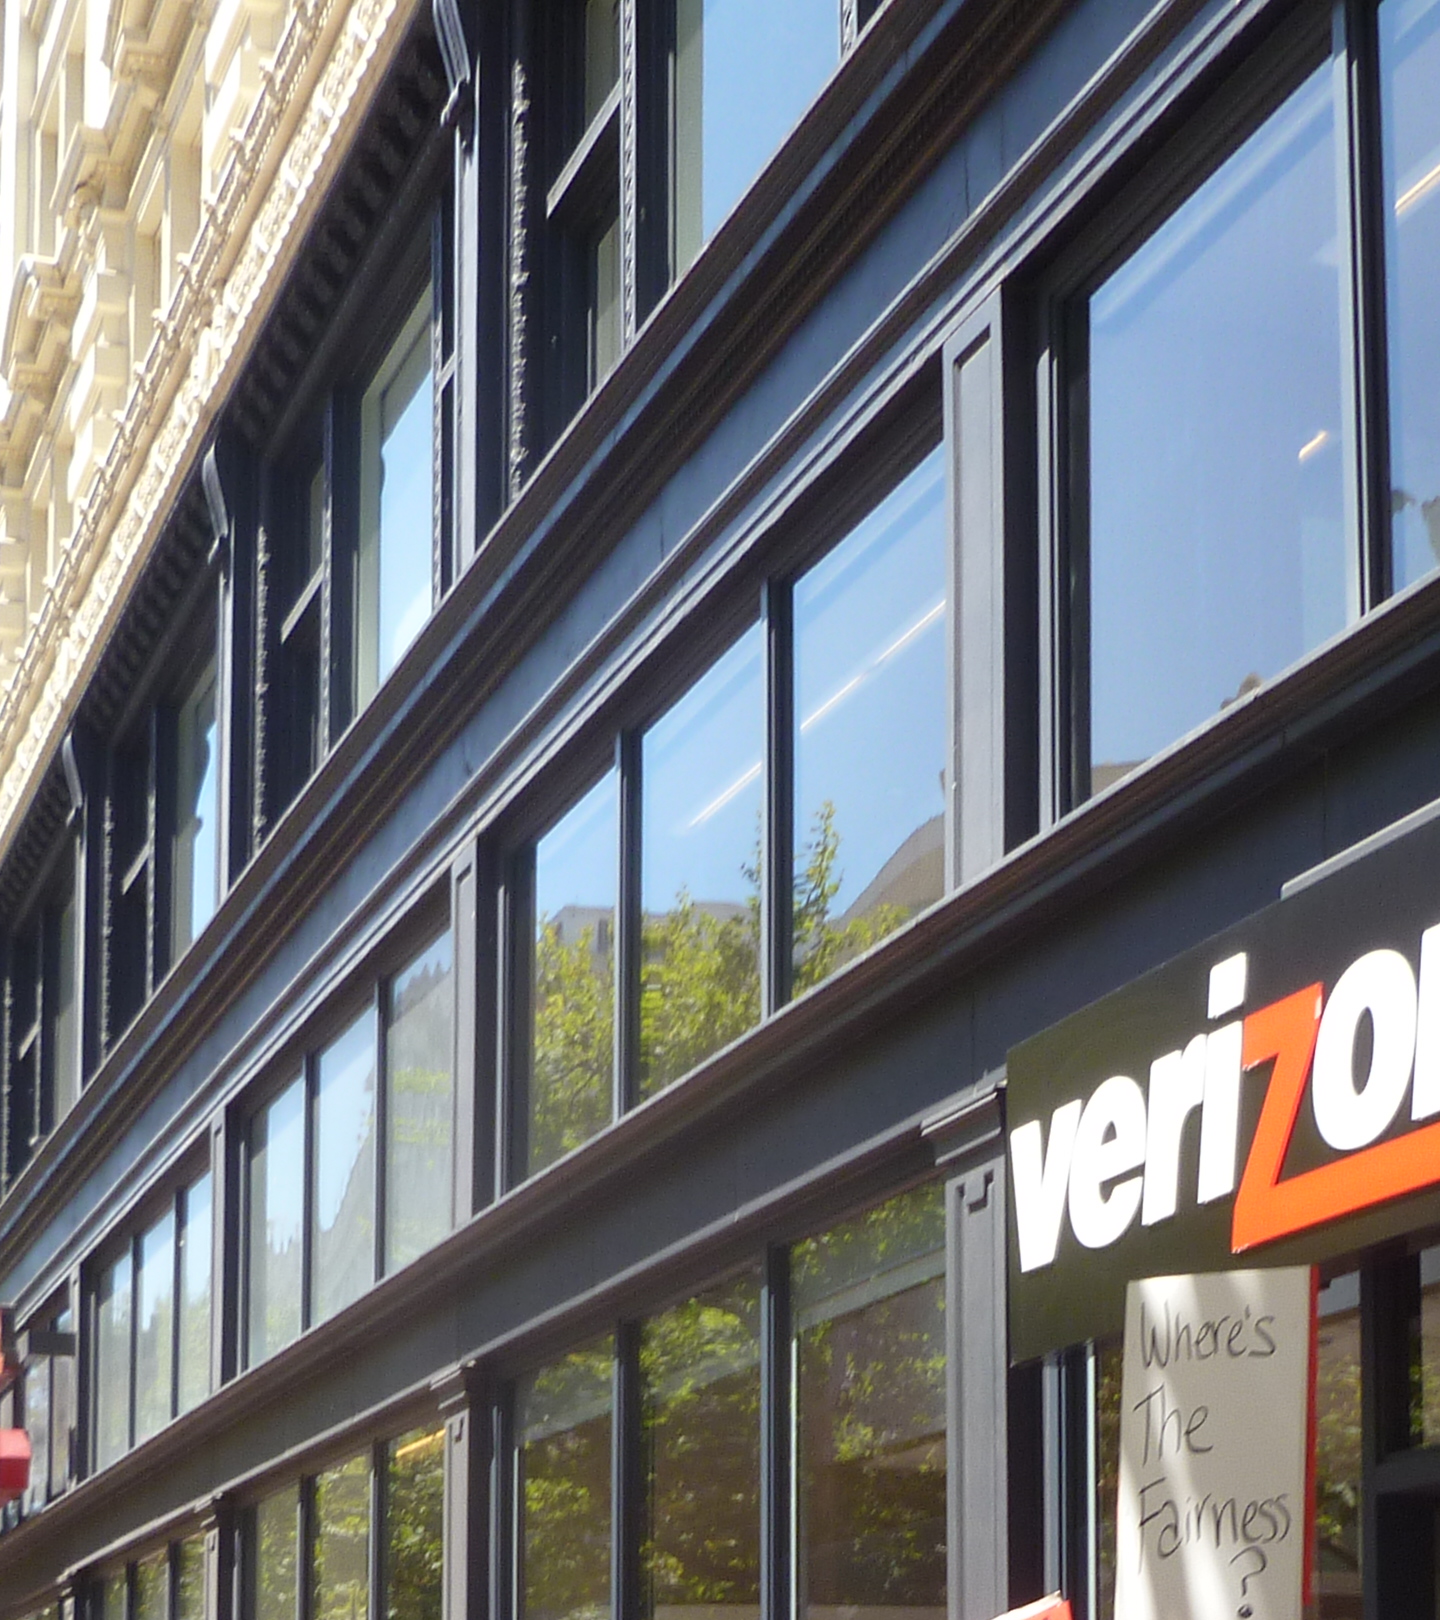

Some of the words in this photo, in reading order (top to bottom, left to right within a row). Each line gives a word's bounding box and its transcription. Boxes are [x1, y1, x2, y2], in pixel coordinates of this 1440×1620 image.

[1140, 1300, 1276, 1369] Where's
[1133, 1384, 1214, 1466] The
[1138, 1478, 1292, 1575] Fairness
[1229, 1545, 1267, 1619] ?
